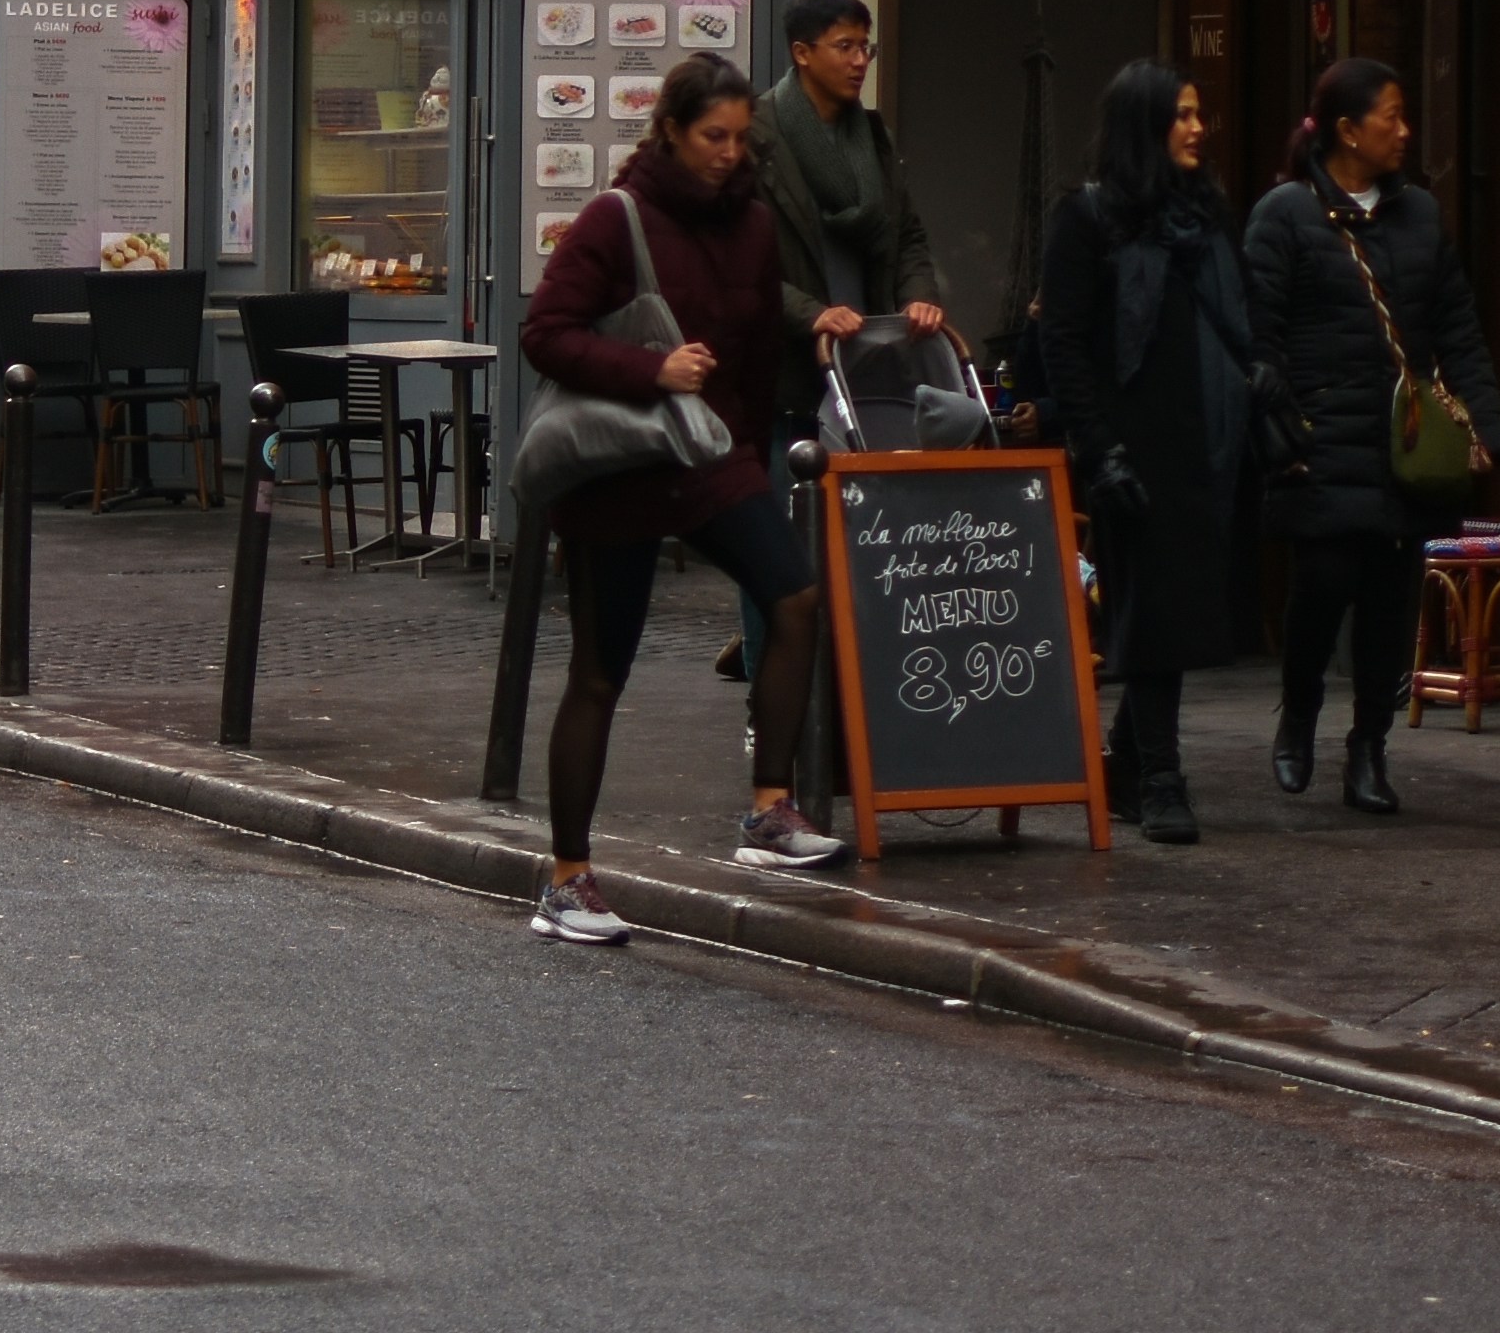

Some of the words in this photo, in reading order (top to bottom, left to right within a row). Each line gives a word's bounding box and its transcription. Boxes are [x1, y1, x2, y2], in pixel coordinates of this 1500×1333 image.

[4, 1, 119, 19] LADELICE
[131, 5, 181, 22] sushi
[33, 20, 70, 33] ASIAN
[72, 20, 105, 34] food
[1189, 23, 1225, 57] WINE
[857, 508, 892, 546] La
[901, 510, 1018, 545] meilleure
[874, 550, 928, 596] frite
[933, 555, 959, 577] de
[901, 587, 1020, 634] MENU
